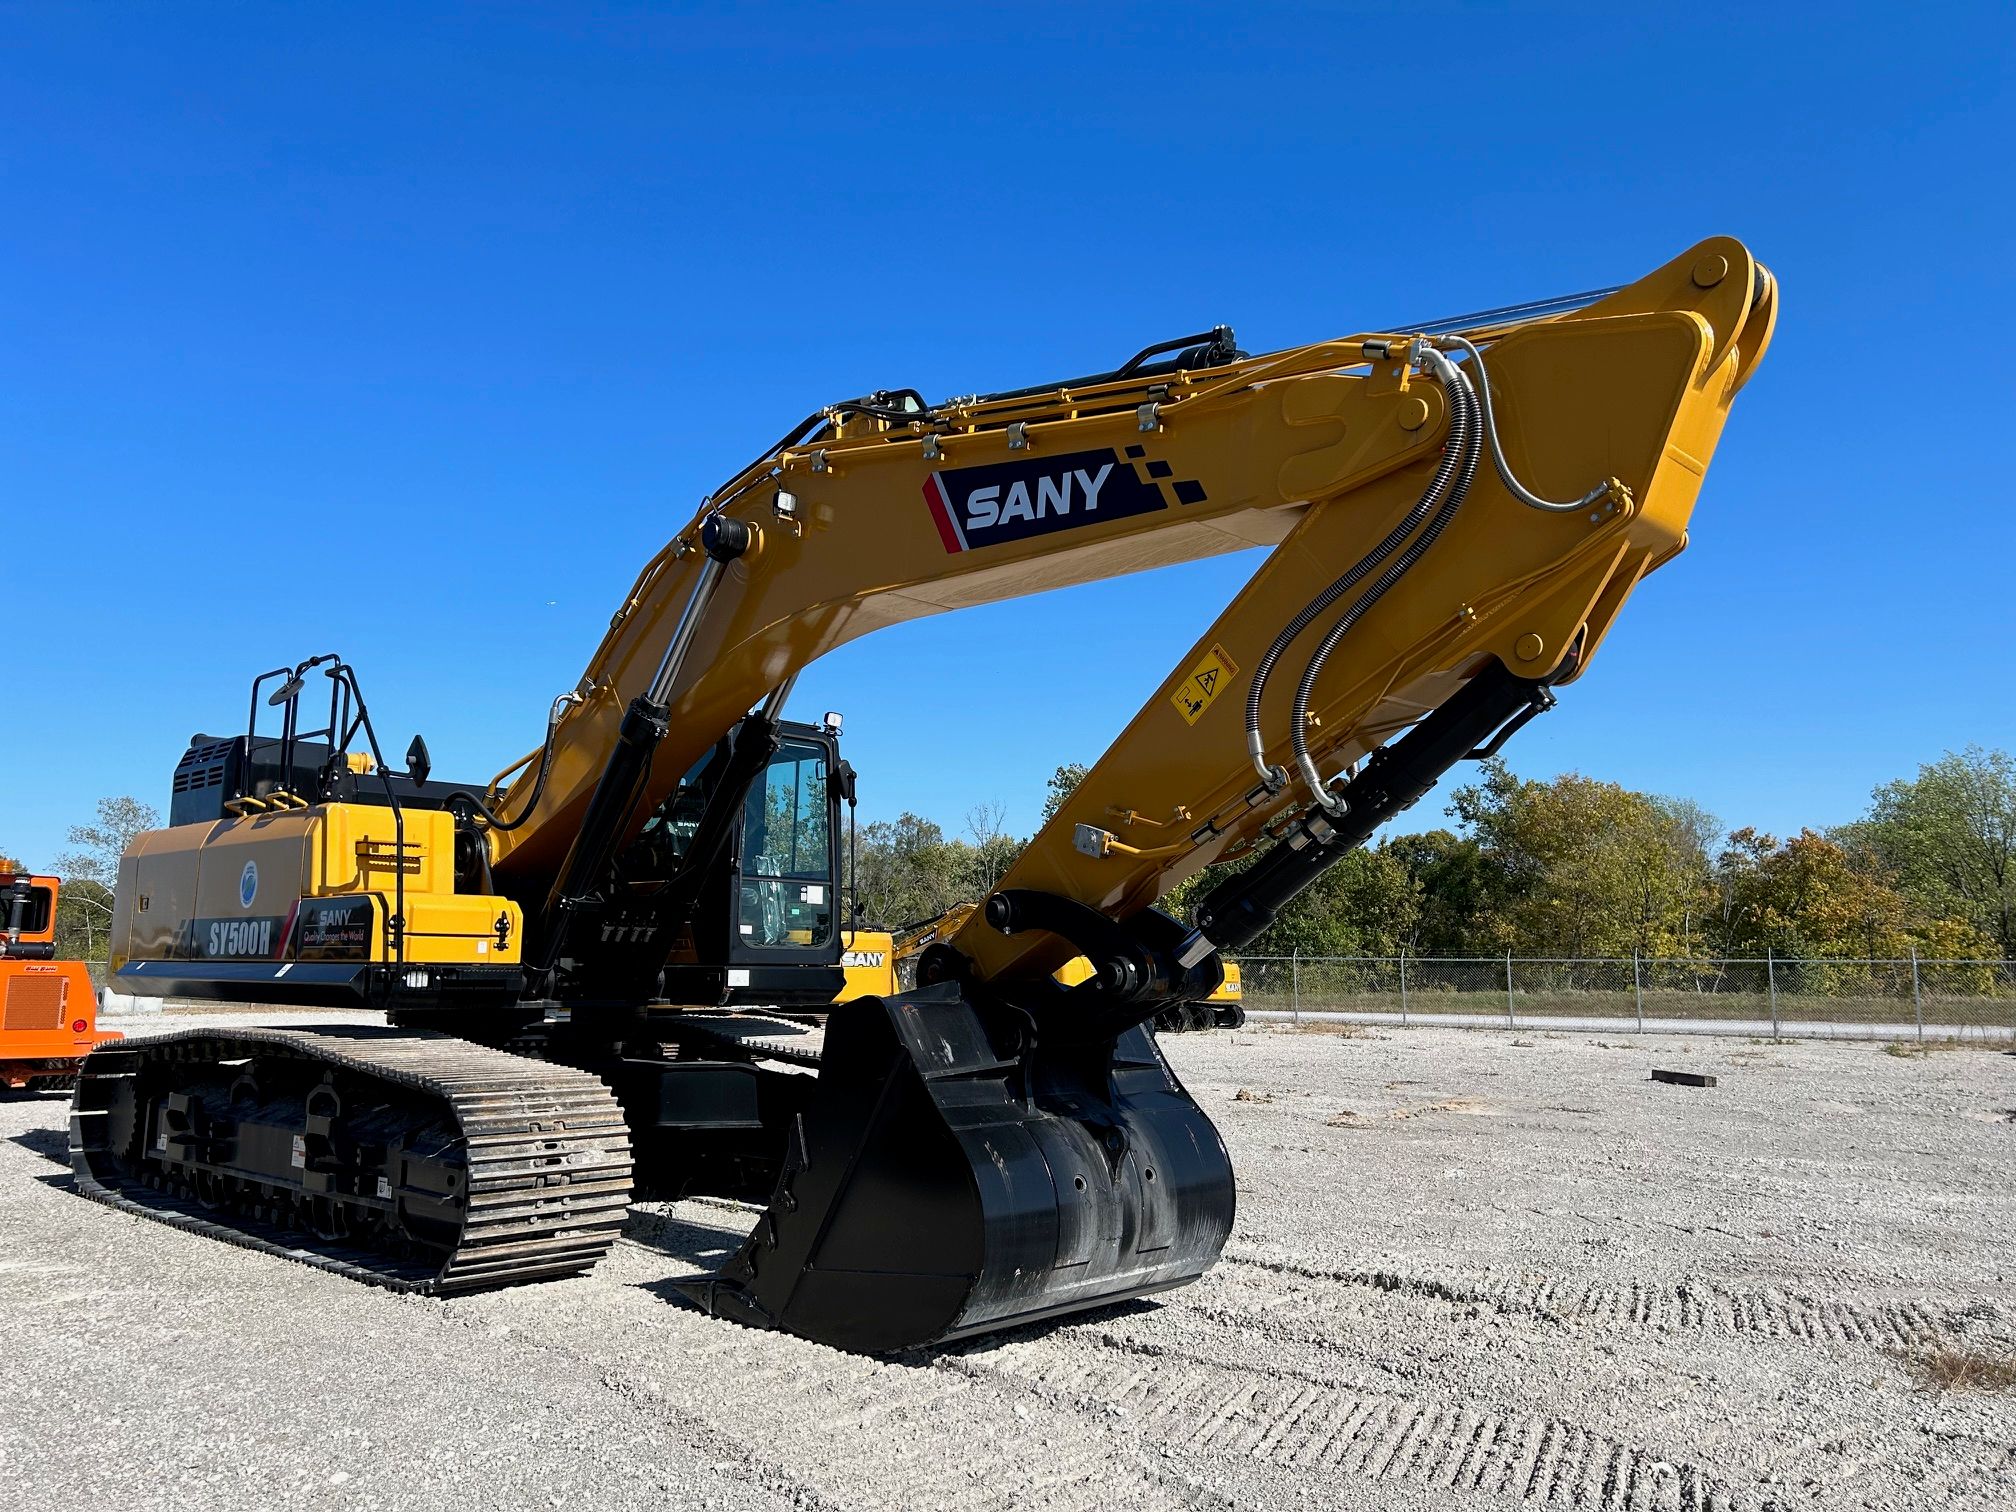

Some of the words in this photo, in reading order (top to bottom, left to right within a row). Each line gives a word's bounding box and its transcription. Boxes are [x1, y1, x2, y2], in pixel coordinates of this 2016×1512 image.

[966, 462, 1115, 530] SANY
[319, 909, 352, 926] SANY
[209, 920, 271, 955] SY500H
[303, 930, 320, 944] Quality
[320, 930, 340, 944] Changes
[340, 929, 348, 941] the
[348, 928, 365, 941] World
[919, 932, 936, 945] SANY
[841, 951, 886, 967] SANY
